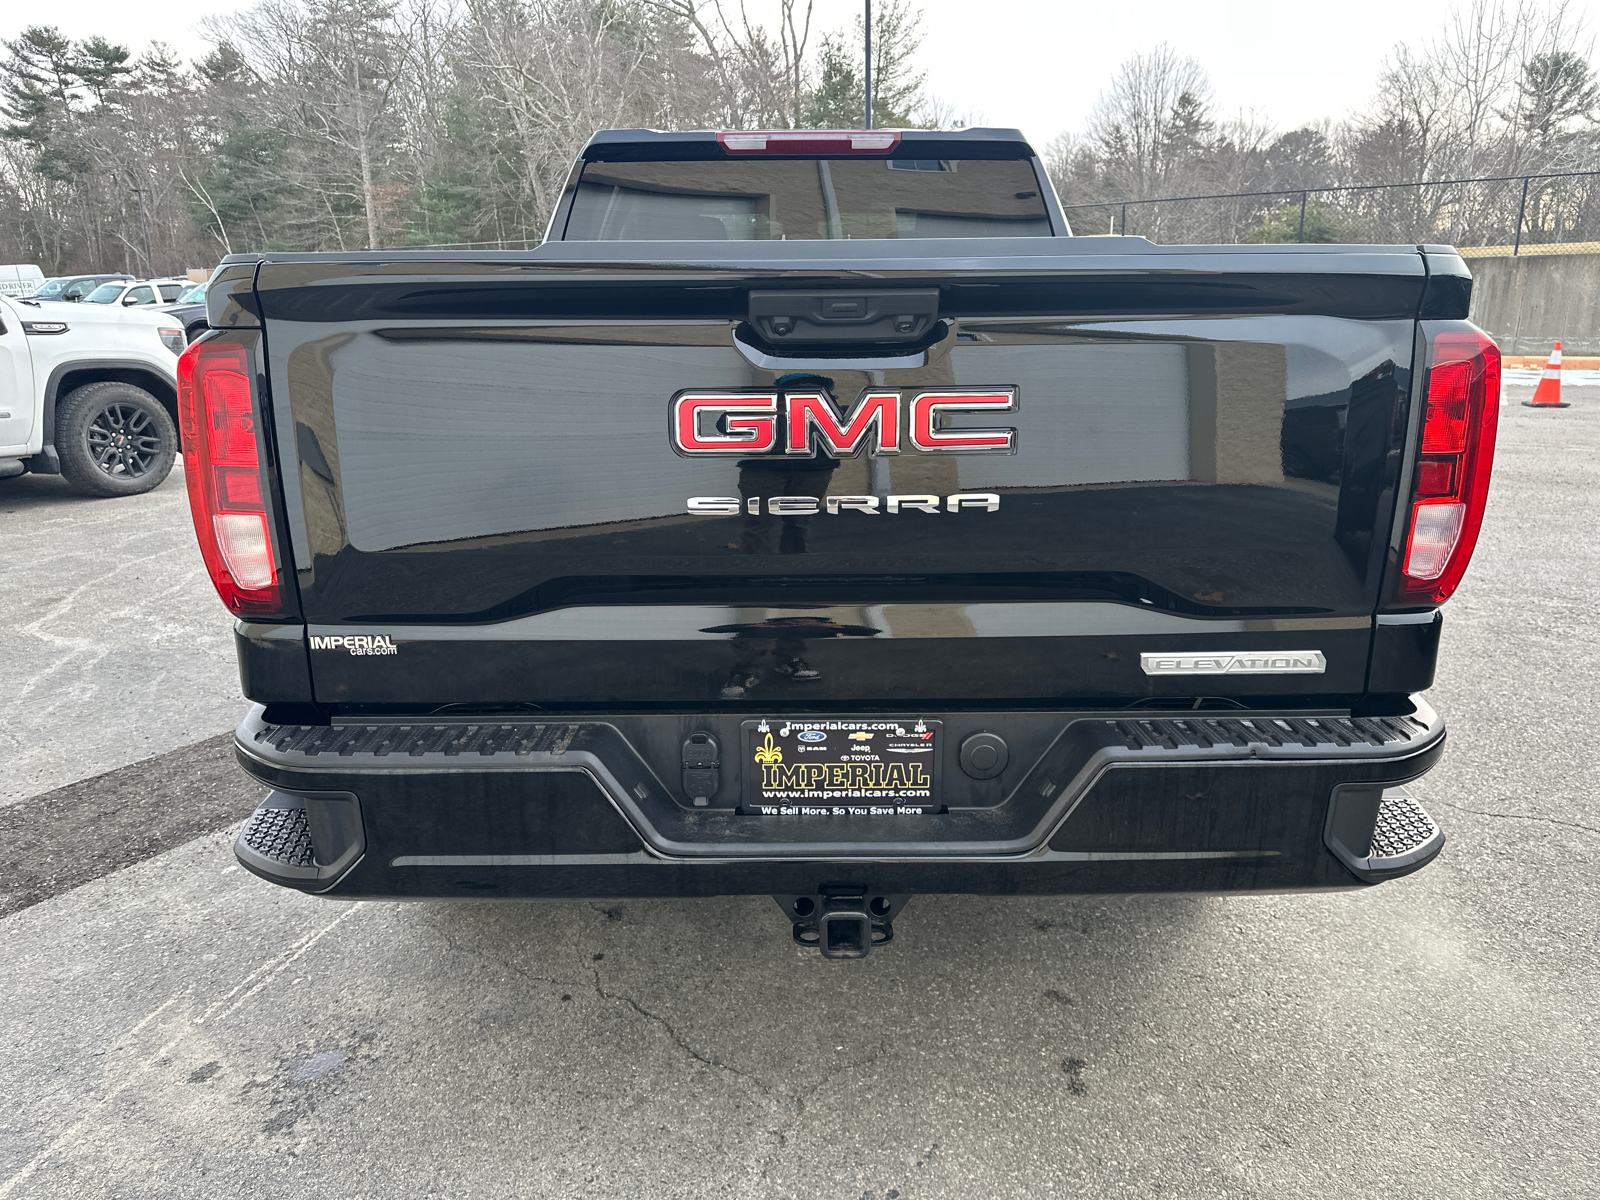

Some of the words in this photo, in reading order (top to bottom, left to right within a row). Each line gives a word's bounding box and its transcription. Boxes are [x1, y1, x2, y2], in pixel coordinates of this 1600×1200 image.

[672, 390, 1018, 455] GMC
[686, 493, 1000, 516] SIERRA
[309, 635, 397, 649] IMPERIAL
[350, 647, 398, 656] cars.com
[1155, 657, 1313, 670] ELEVATION
[785, 721, 899, 732] Imperialcars.com
[850, 744, 871, 753] Jeep
[762, 763, 930, 789] IMPERIAL
[762, 789, 930, 799] www.imperialcars.com
[780, 807, 799, 815] Sell
[832, 807, 846, 815] So
[848, 807, 867, 815] You
[870, 807, 894, 815] Save
[897, 806, 922, 814] More
